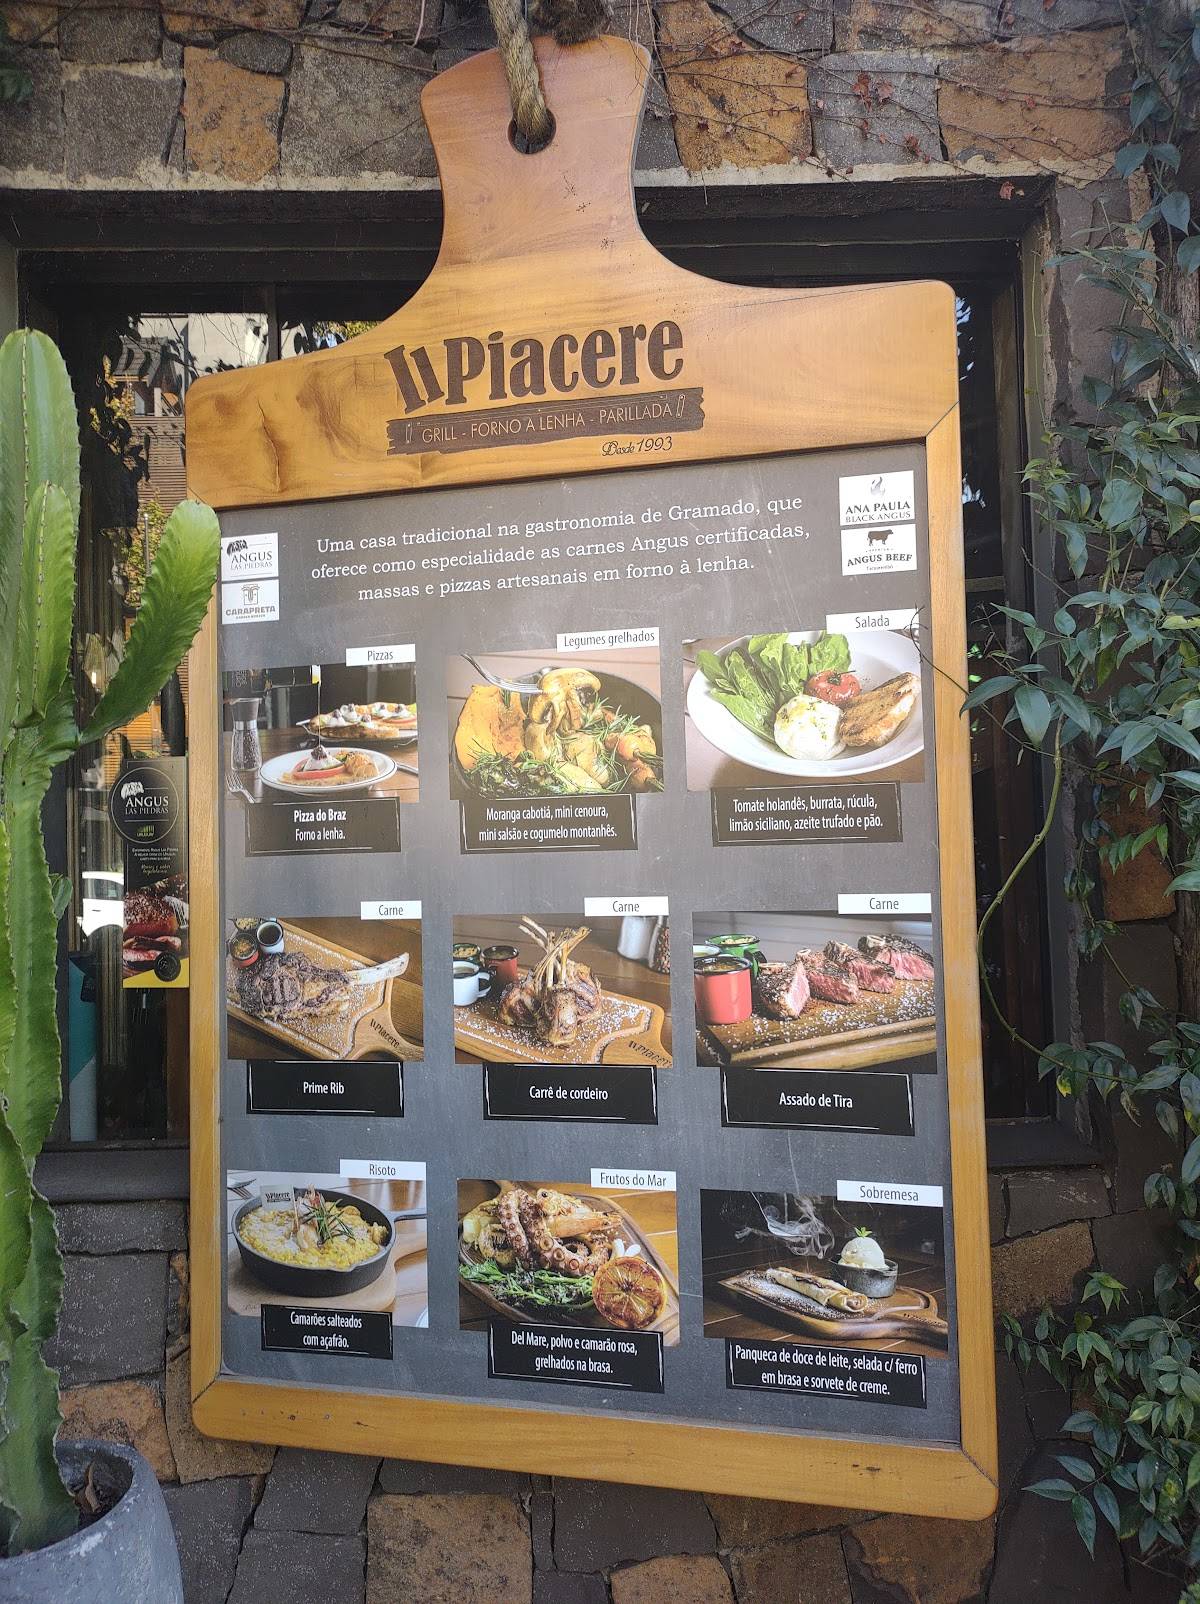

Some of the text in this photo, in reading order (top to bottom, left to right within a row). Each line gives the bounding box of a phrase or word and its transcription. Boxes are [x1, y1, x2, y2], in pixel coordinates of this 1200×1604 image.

[443, 320, 684, 405] Piacere
[422, 425, 457, 443] GRILL
[471, 419, 521, 438] FORNO
[525, 419, 536, 432] A
[539, 413, 586, 430] LENHA
[599, 403, 672, 424] PARILLADA
[637, 435, 673, 452] 1993
[846, 501, 911, 515] ANA PAULA
[317, 497, 803, 553] Uma casa tradicional na gastronomia de Gramado, que
[845, 511, 911, 523] BLACK ANGUS
[231, 551, 273, 564] ANGUS
[311, 523, 810, 580] oferece como especialidade as carnes Angus certificadas,
[847, 554, 882, 567] ANGUS
[886, 553, 913, 562] BEEF
[358, 555, 755, 601] massas e pizzas artesanais em forno à lenha.
[225, 605, 276, 616] CARAPRETA
[855, 615, 890, 629] Salada
[564, 630, 655, 650] Legumes grelhados
[367, 650, 394, 662] Pizzas
[125, 795, 169, 808] ANGUS
[733, 794, 878, 813] Tomate holandês, burrata, rúcula,
[294, 808, 346, 823] Pizza do Braz
[486, 806, 609, 823] Moranga cabotiá, mini cenoura,
[729, 814, 883, 833] limão siciliano, azeite trufado e pão.
[295, 827, 346, 842] Forno a lenha.
[479, 825, 617, 843] mini salsão e cogumelo montanhês.
[378, 904, 404, 916] Carne
[612, 900, 640, 913] Carne
[869, 897, 899, 910] Carne
[303, 1081, 345, 1094] Prime Rib
[529, 1085, 608, 1100] Carrê de cordeiro
[779, 1092, 853, 1108] Assado de Tira
[369, 1163, 396, 1176] Risoto
[600, 1172, 667, 1187] Frutos do Mar
[859, 1185, 919, 1202] Sobremesa
[290, 1311, 362, 1329] Camarões salteados
[303, 1334, 349, 1350] com açafrão.
[511, 1330, 638, 1356] Del Mare, polvo e camarão rosa,
[535, 1354, 613, 1374] grelhados na brasa.
[735, 1344, 918, 1376] Panqueca de doce de leite, selada c/ ferro
[761, 1370, 890, 1396] em brasa e sorvete de creme.
